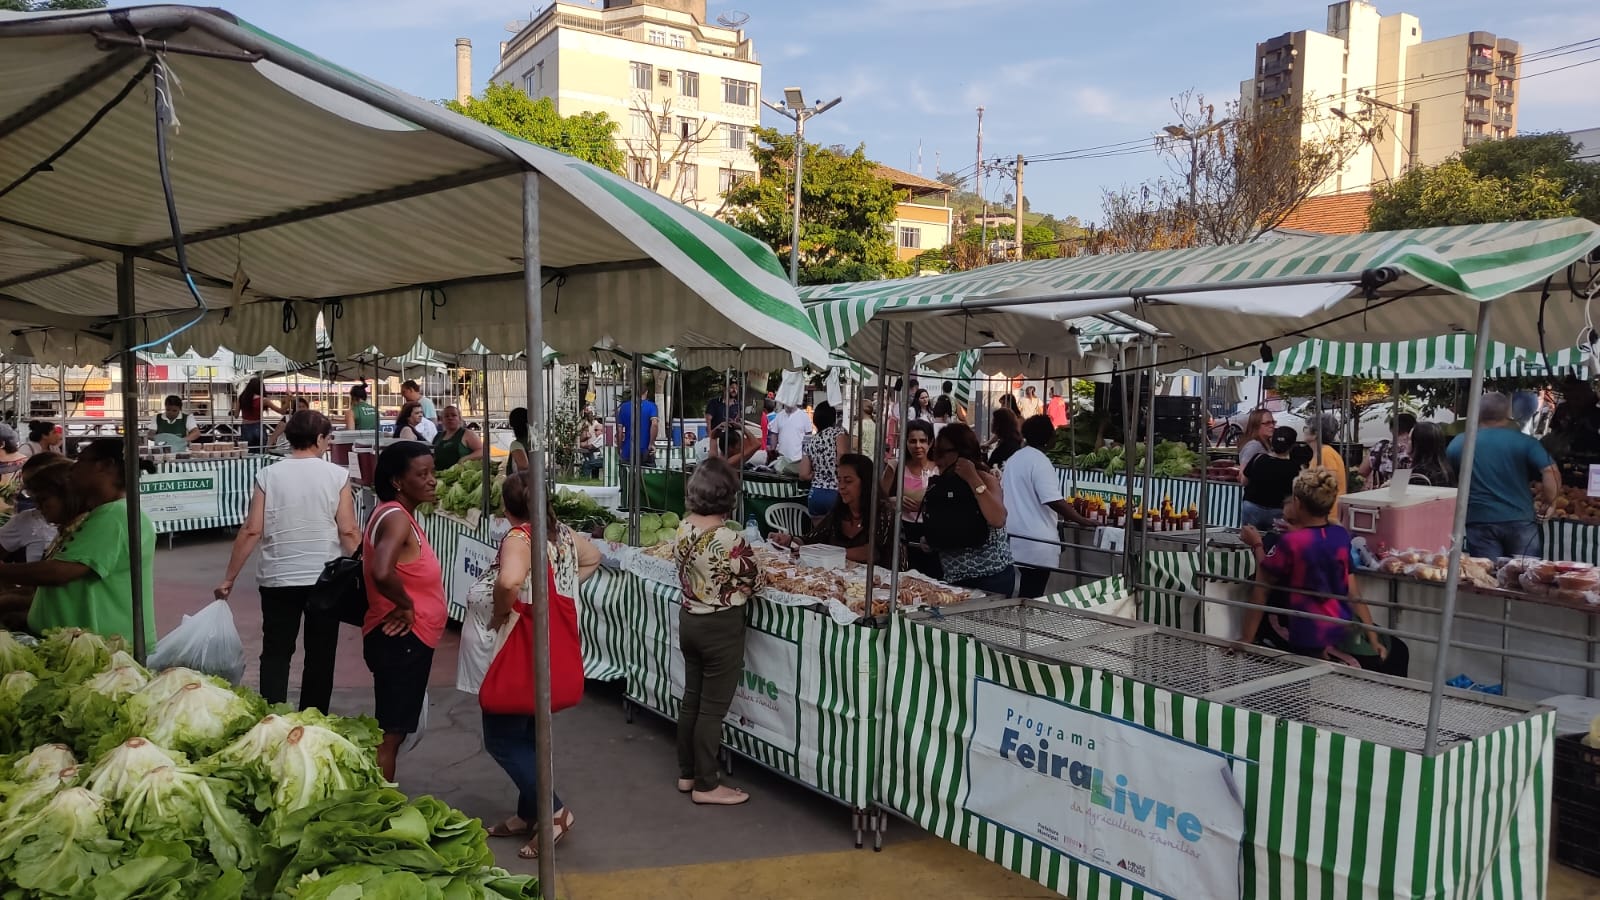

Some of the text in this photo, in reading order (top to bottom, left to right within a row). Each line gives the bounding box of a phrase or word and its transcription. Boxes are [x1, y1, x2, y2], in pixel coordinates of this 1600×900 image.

[152, 482, 175, 491] TEM
[177, 480, 209, 490] FEIRA!
[1006, 707, 1096, 751] Programa
